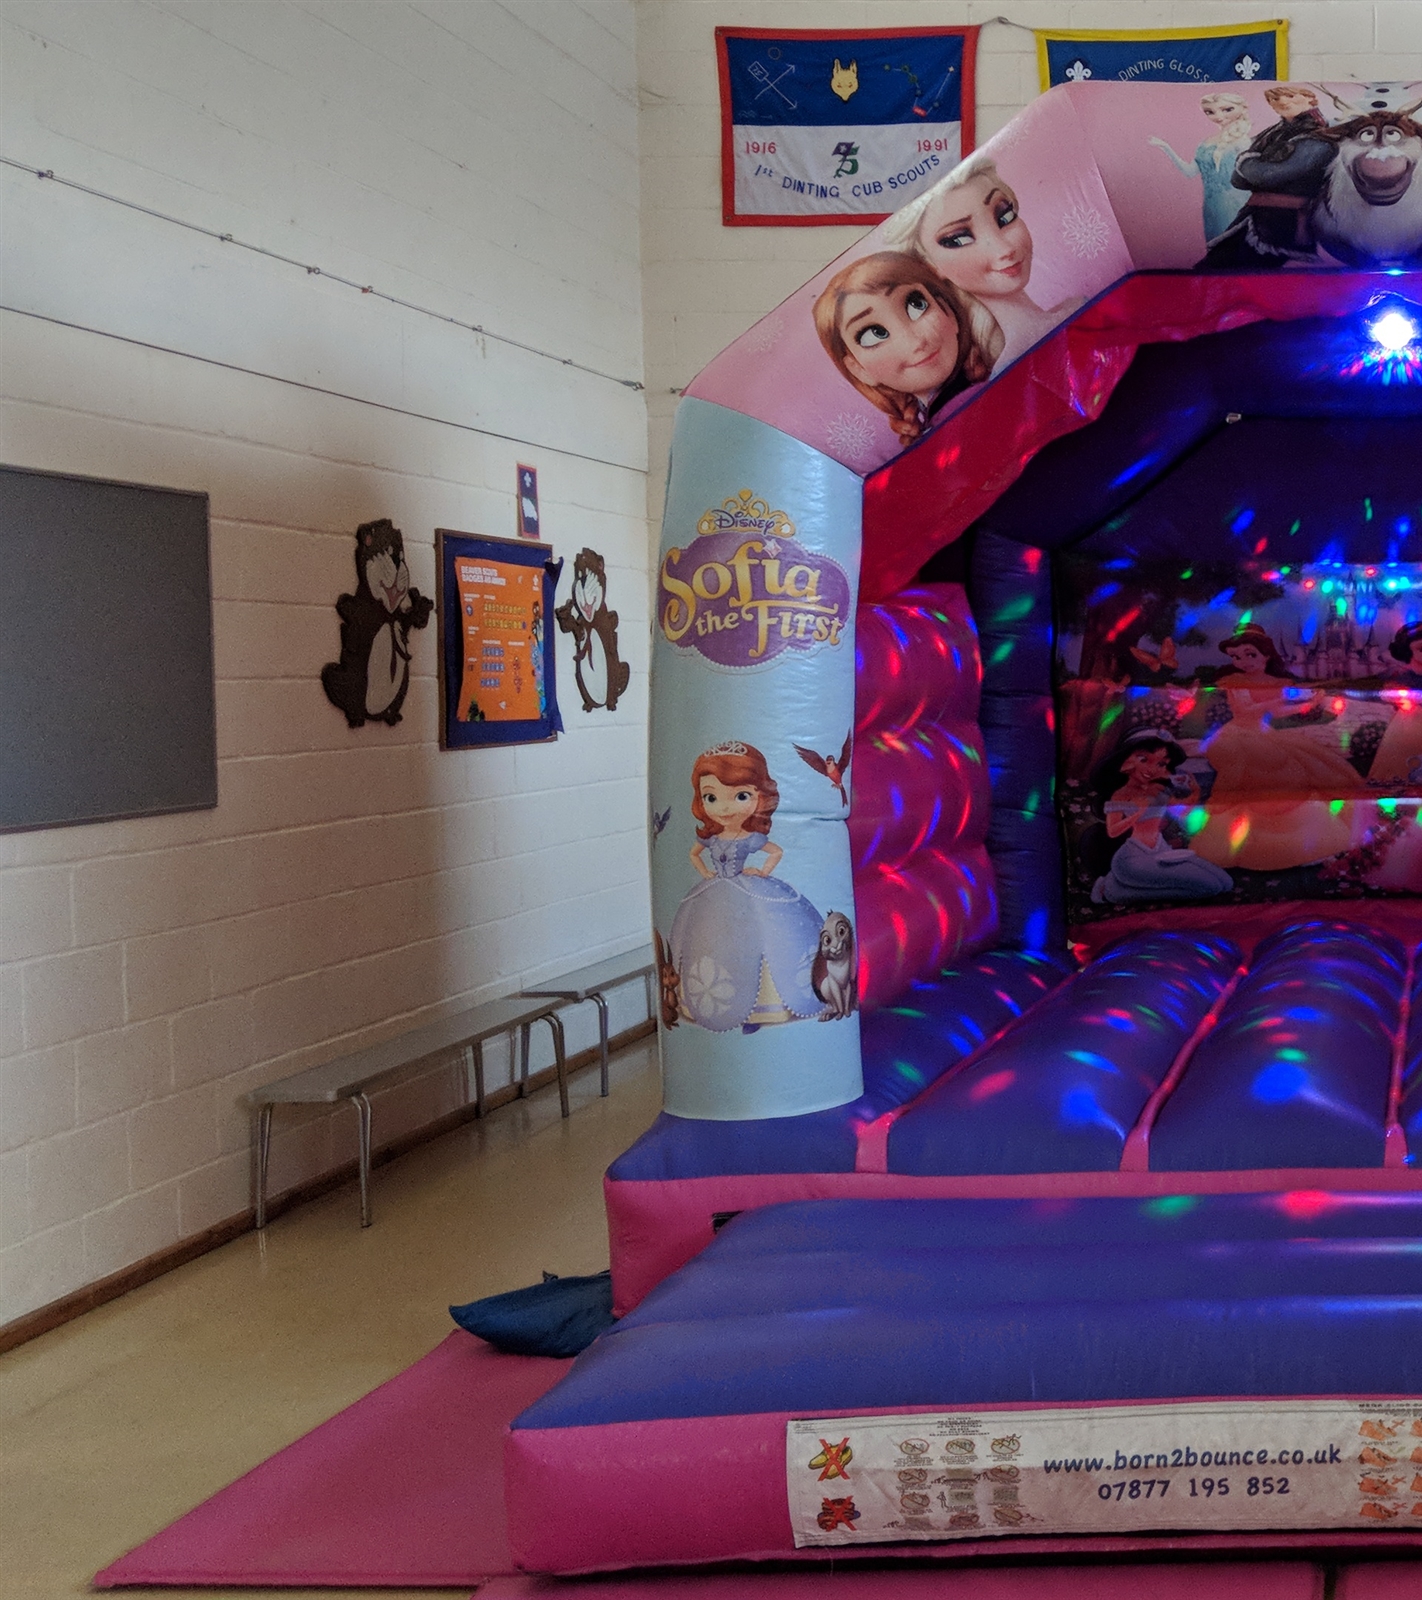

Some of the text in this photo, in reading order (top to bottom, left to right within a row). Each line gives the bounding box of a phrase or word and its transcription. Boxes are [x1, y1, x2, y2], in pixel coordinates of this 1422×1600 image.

[1118, 58, 1216, 83] DINTING GLOSS
[745, 141, 777, 154] 1916
[917, 138, 948, 152] 1991
[754, 154, 941, 198] 1st DINTING CUB SCOUTS
[662, 541, 822, 642] Sofia
[695, 600, 843, 657] the First
[1043, 1443, 1342, 1474] www.born2bounce.co.uk
[1097, 1476, 1290, 1501] 07877 195 852
